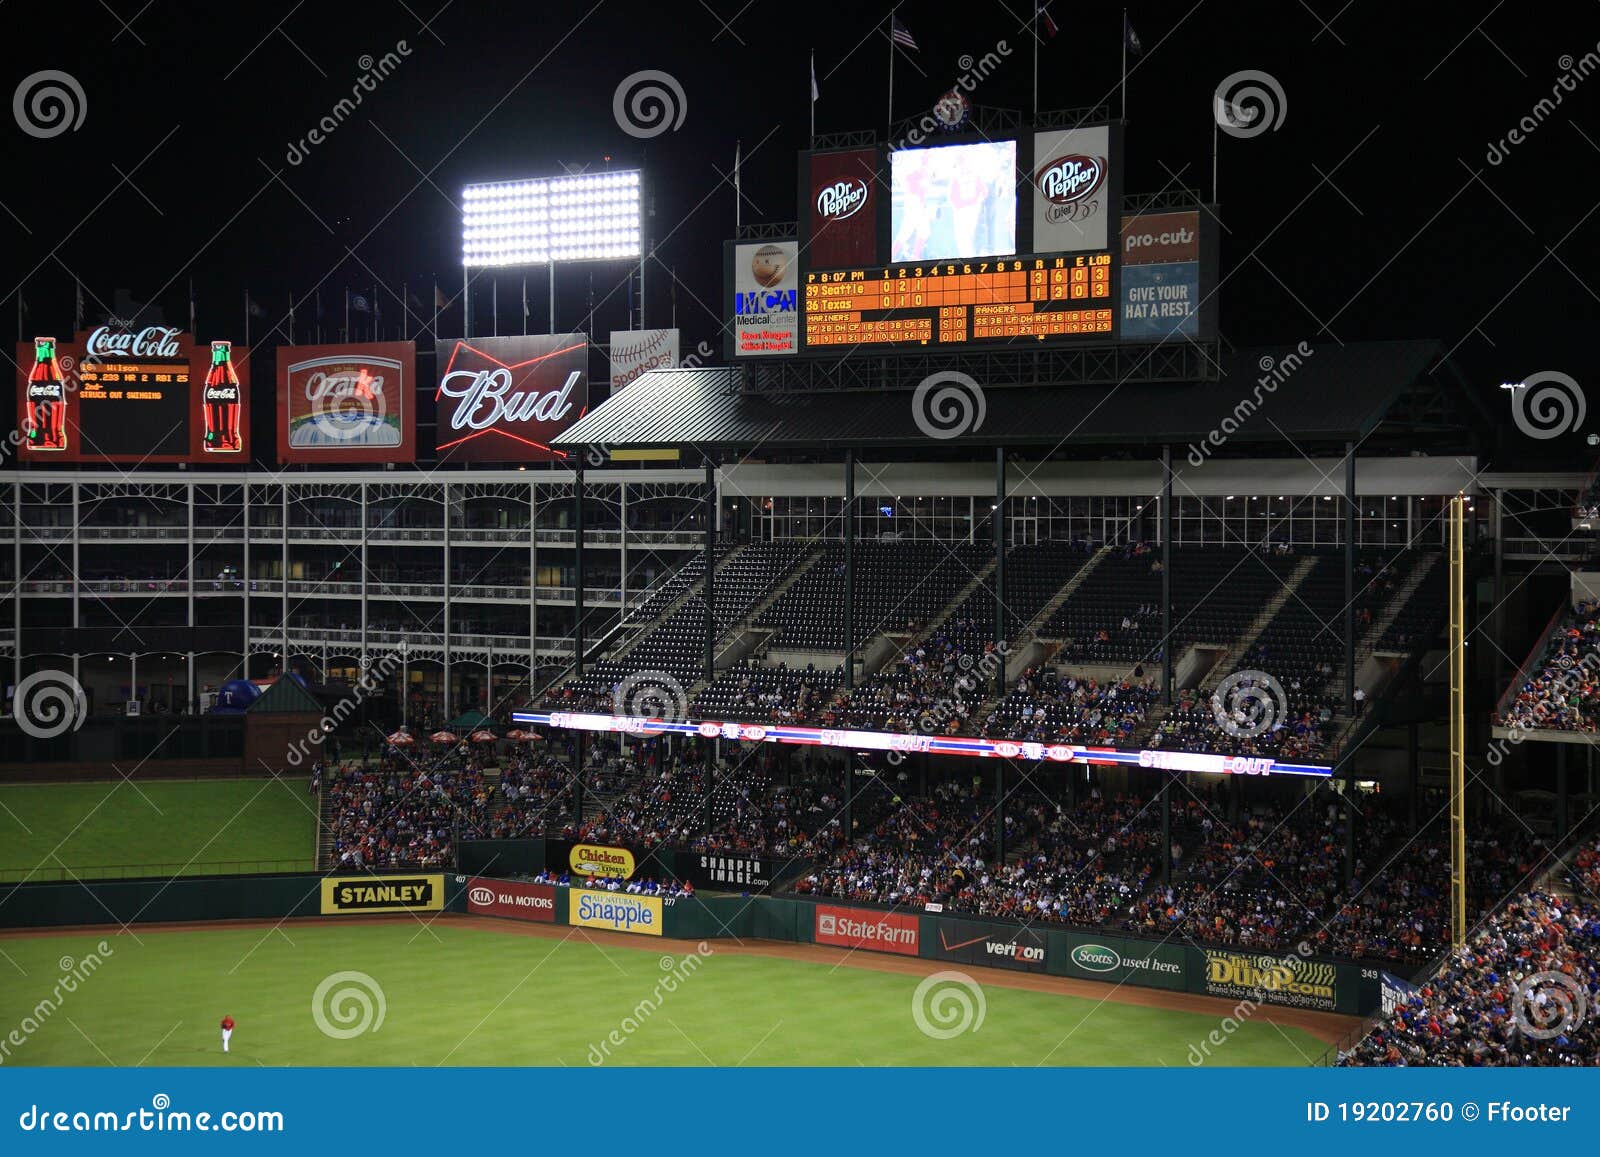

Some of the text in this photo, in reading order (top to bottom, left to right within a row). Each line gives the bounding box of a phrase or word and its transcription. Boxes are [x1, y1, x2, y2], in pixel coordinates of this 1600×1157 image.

[1062, 161, 1082, 180] Dr
[1048, 165, 1095, 198] Pepper
[835, 182, 852, 199] Dr
[822, 187, 864, 218] Pepper
[809, 255, 1110, 282] P 8:07 PM 1 2 3 4 5 6 7 8 9 R H E LOB
[806, 268, 1104, 296] 39 Seattle 0 2 3 6 0 3
[806, 284, 1104, 311] 36 Texas 0 0 3 0 3
[1129, 285, 1188, 302] GIVE YOUR
[808, 314, 850, 322] MARINERS
[976, 305, 1016, 314] RANGERS
[1126, 302, 1193, 319] HAT A REST.
[305, 369, 384, 400] Ozarka
[441, 369, 581, 430] Bud
[224, 691, 232, 704] T
[1231, 757, 1274, 776] OUT
[579, 848, 625, 864] Chicken
[701, 857, 761, 874] SHARPER
[455, 875, 466, 884] 407
[341, 886, 426, 904] STANLEY
[473, 891, 490, 902] KIA
[499, 894, 553, 909] KIA MOTORS
[664, 898, 675, 906] 377
[579, 895, 652, 928] Snapple
[986, 942, 1044, 961] verizon
[1079, 950, 1181, 974] Scotts used here.
[1229, 955, 1252, 968] THE
[1361, 969, 1378, 979] 349
